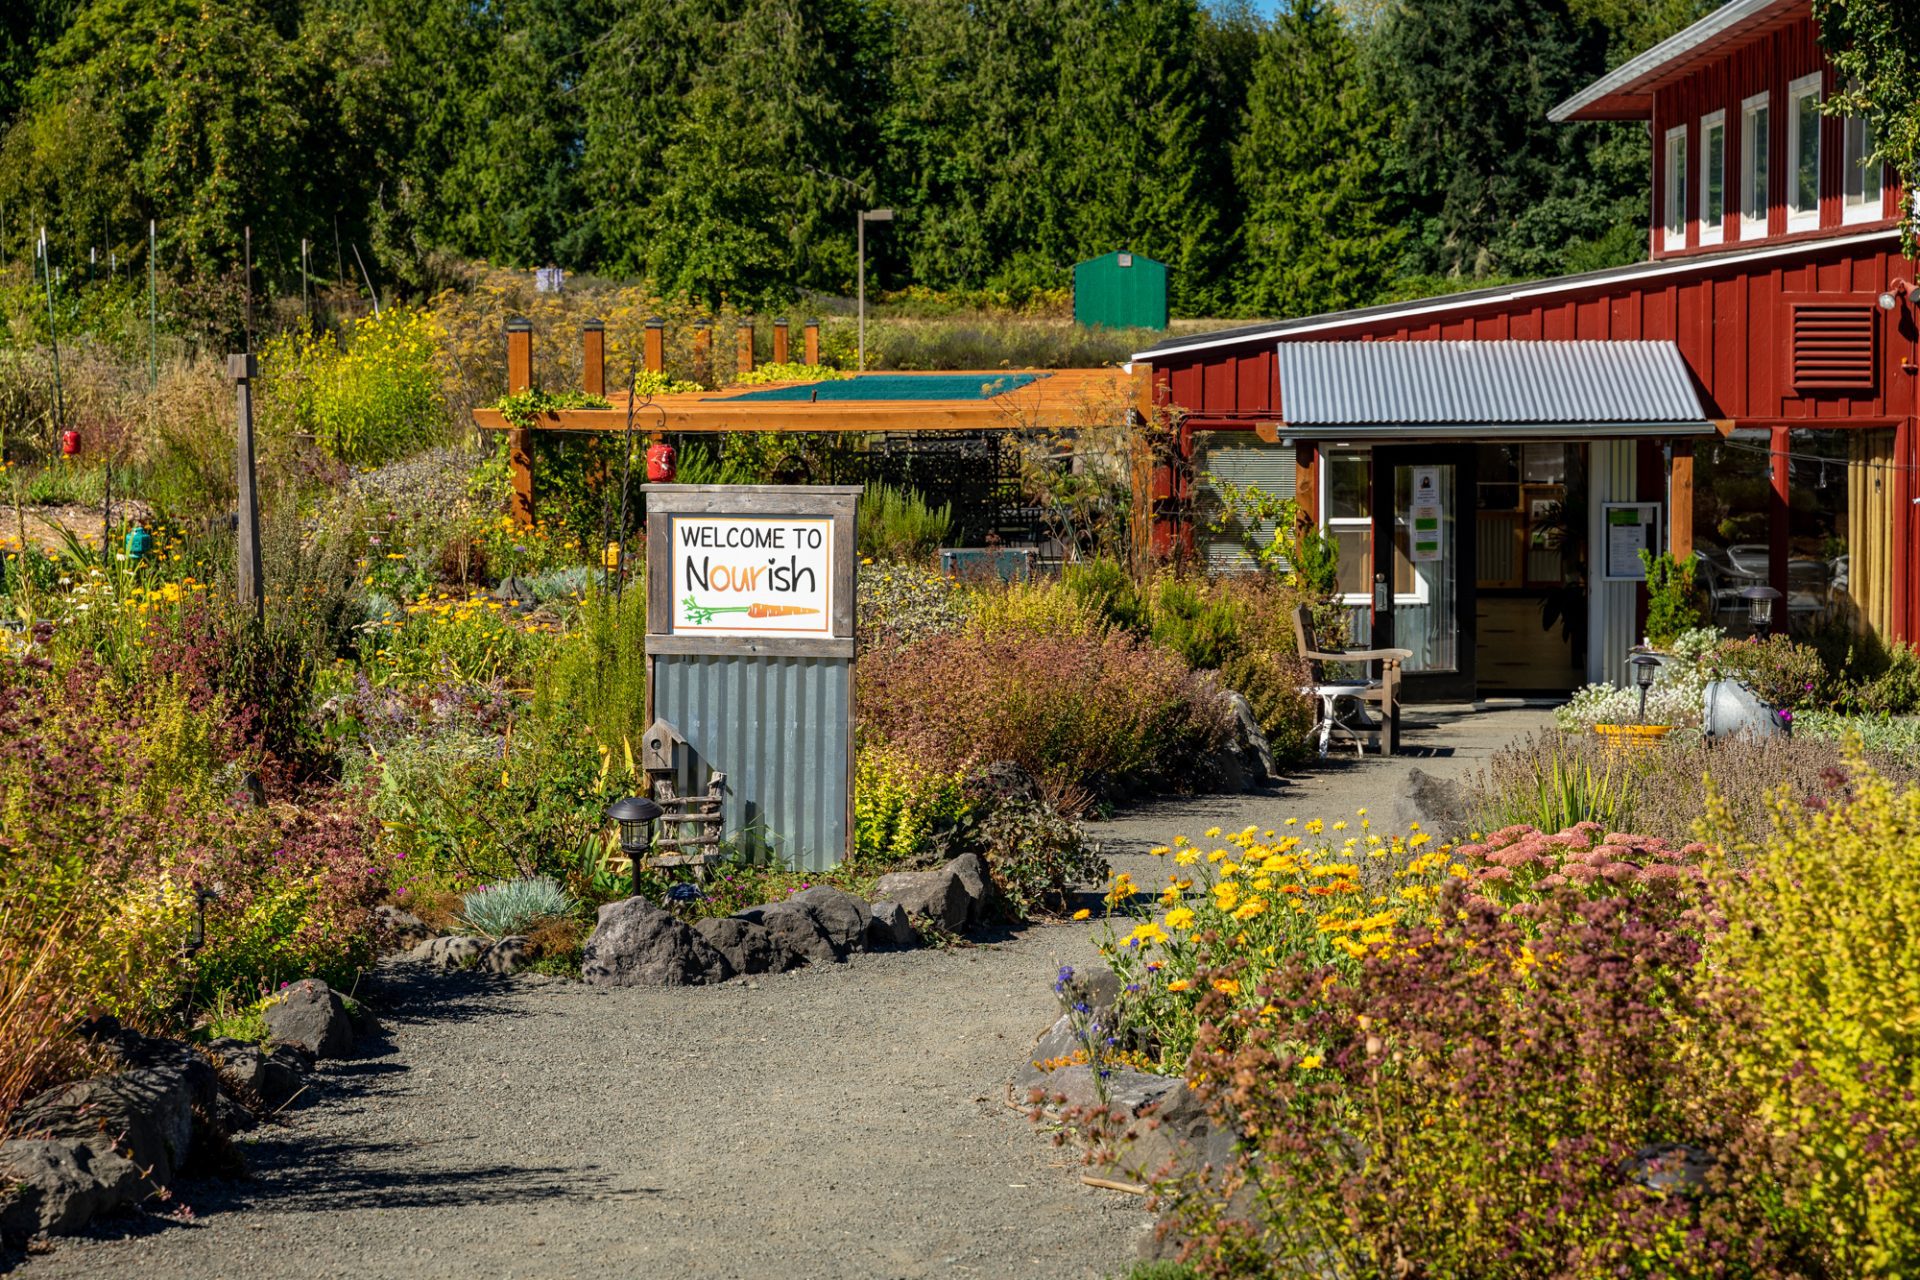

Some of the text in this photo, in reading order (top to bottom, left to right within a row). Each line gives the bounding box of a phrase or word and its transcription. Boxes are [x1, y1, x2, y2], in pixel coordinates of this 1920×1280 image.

[681, 526, 822, 549] WELCOME TO
[686, 555, 816, 593] Nourish
